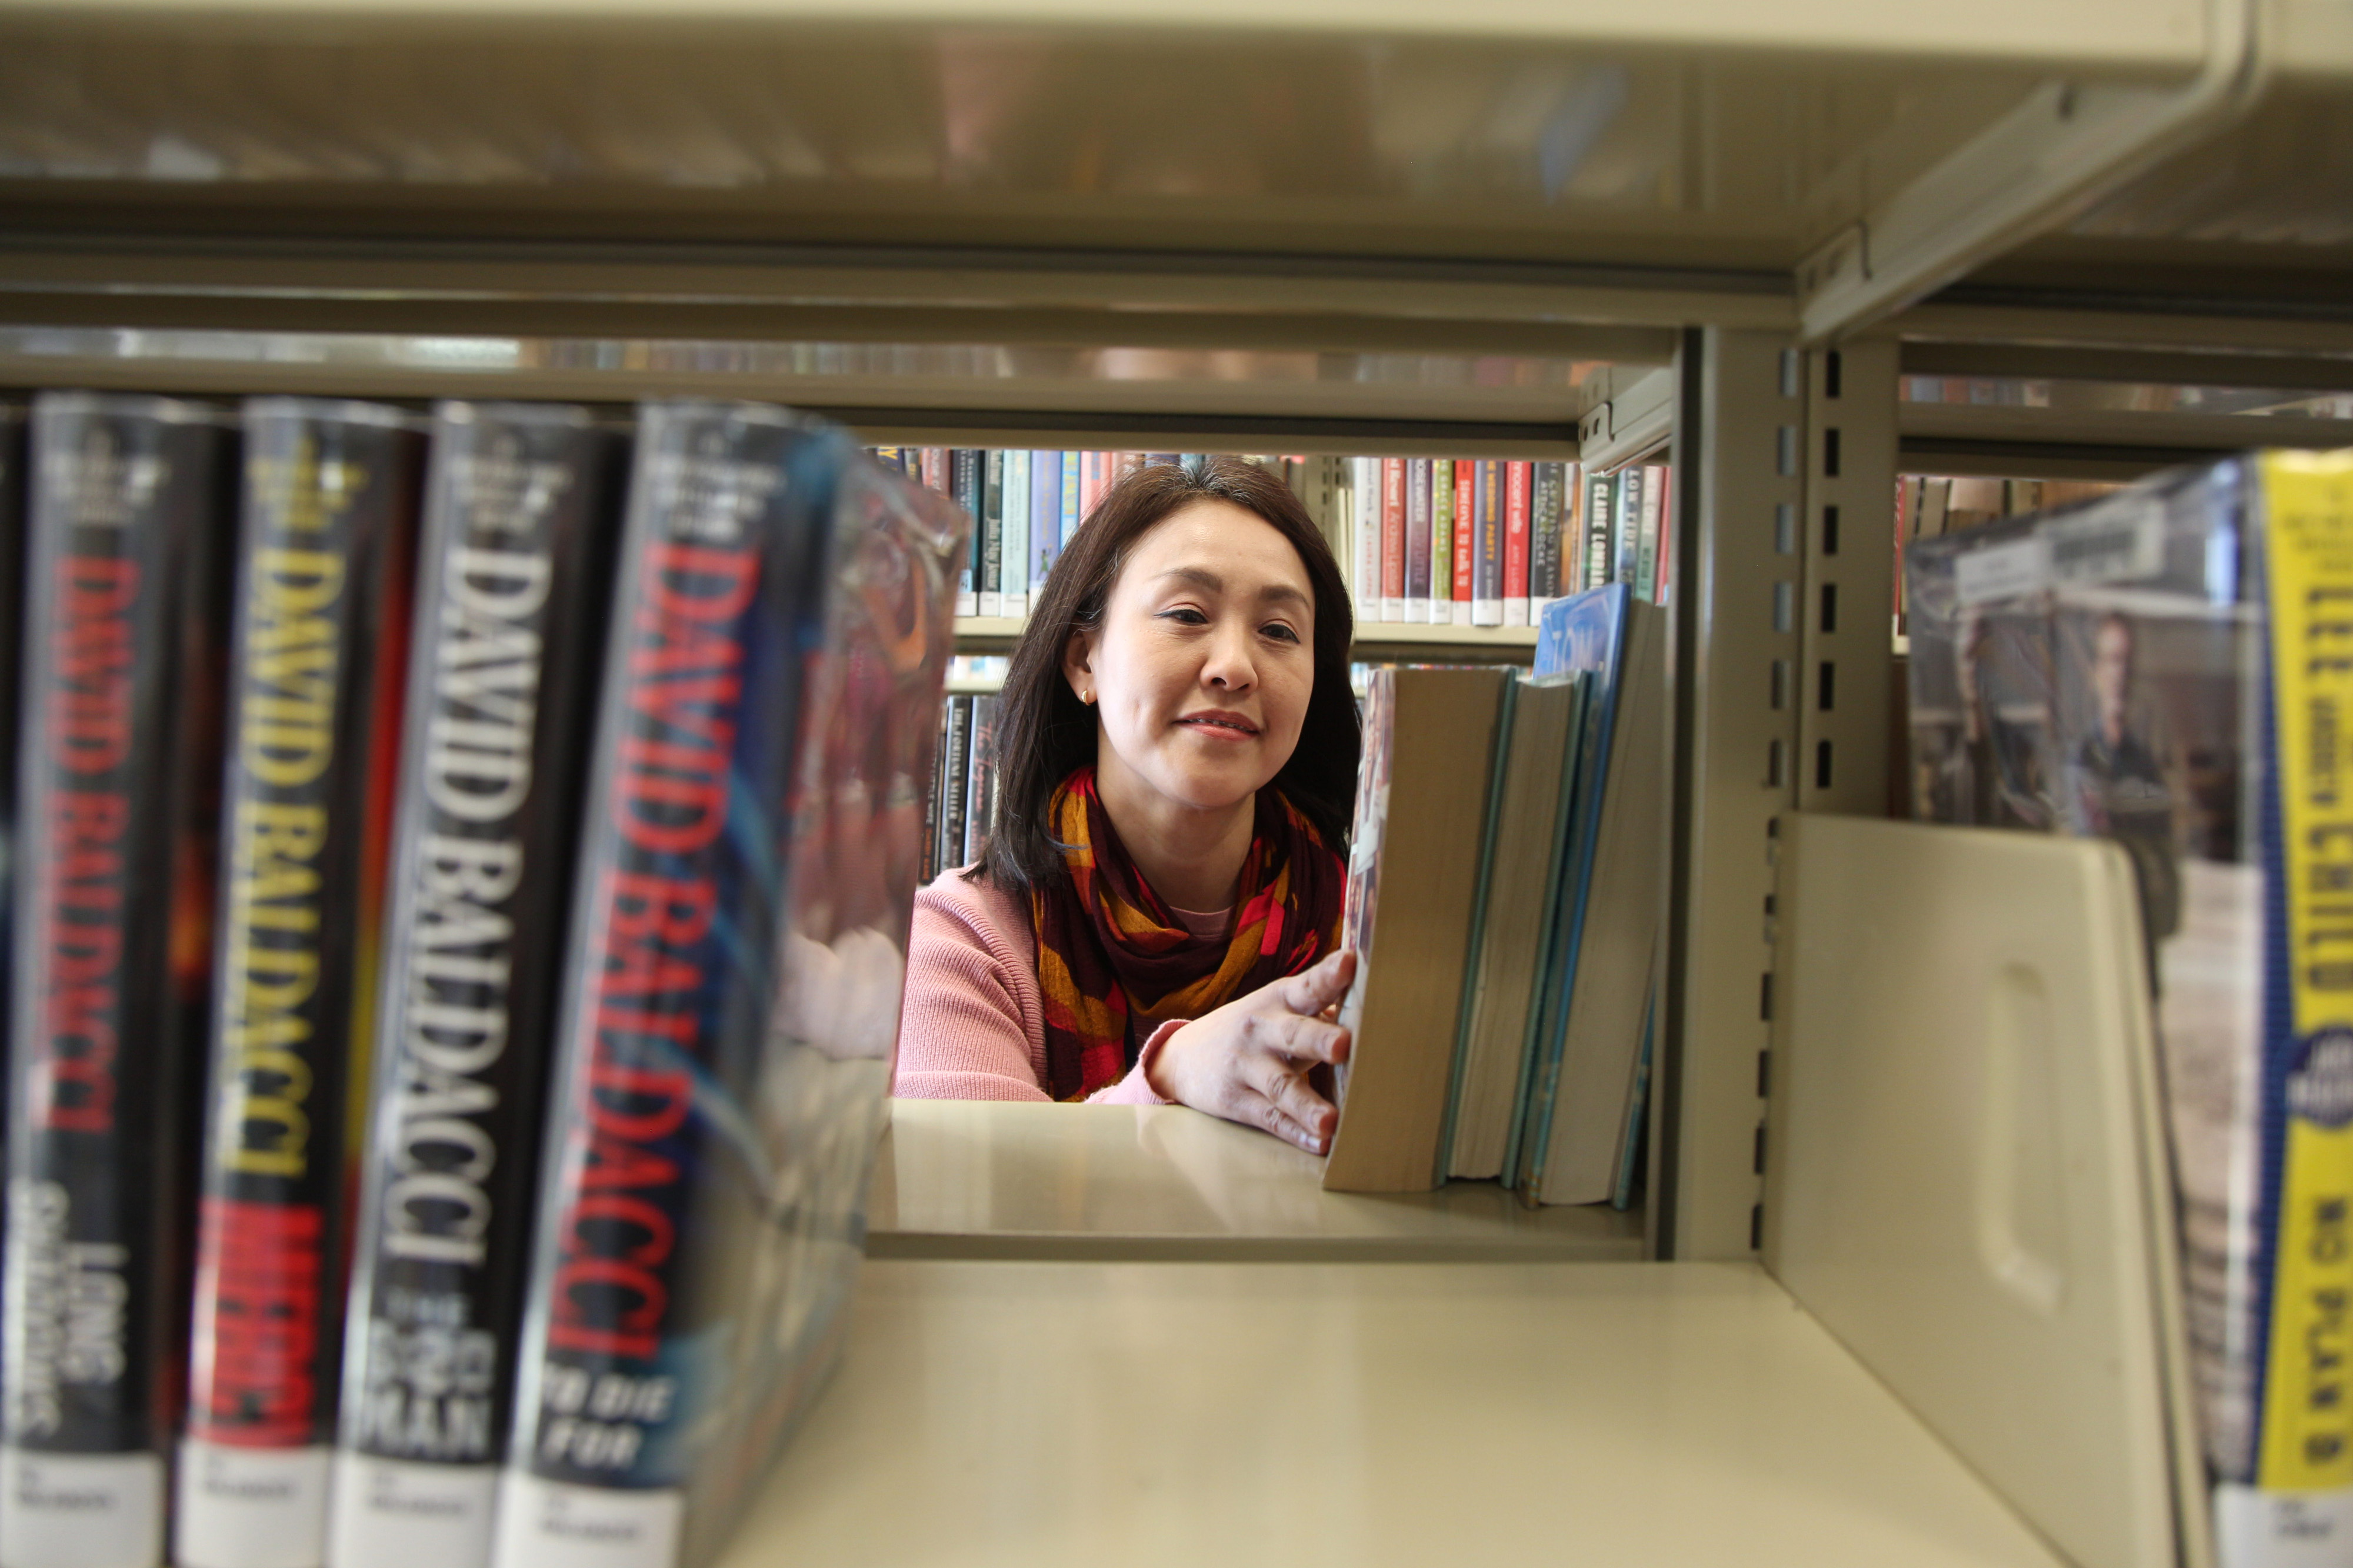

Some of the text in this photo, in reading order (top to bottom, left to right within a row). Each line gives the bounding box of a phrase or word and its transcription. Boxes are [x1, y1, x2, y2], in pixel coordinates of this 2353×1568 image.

[931, 449, 941, 477] ouse
[1485, 523, 1495, 561] PARTY
[1511, 462, 1523, 509] nnocent
[1592, 483, 1609, 529] CLAIRE
[46, 554, 142, 774] DAVID
[240, 549, 347, 787] DAVID
[429, 550, 554, 822] DAVID
[609, 544, 762, 854] DAVID
[29, 789, 131, 1134] BALDACCI
[219, 800, 329, 1176] BALDACCI
[382, 834, 525, 1267] BALDACCI
[544, 870, 719, 1360] BALDACCI
[61, 1240, 129, 1384] LONG
[540, 1414, 644, 1472] FOR
